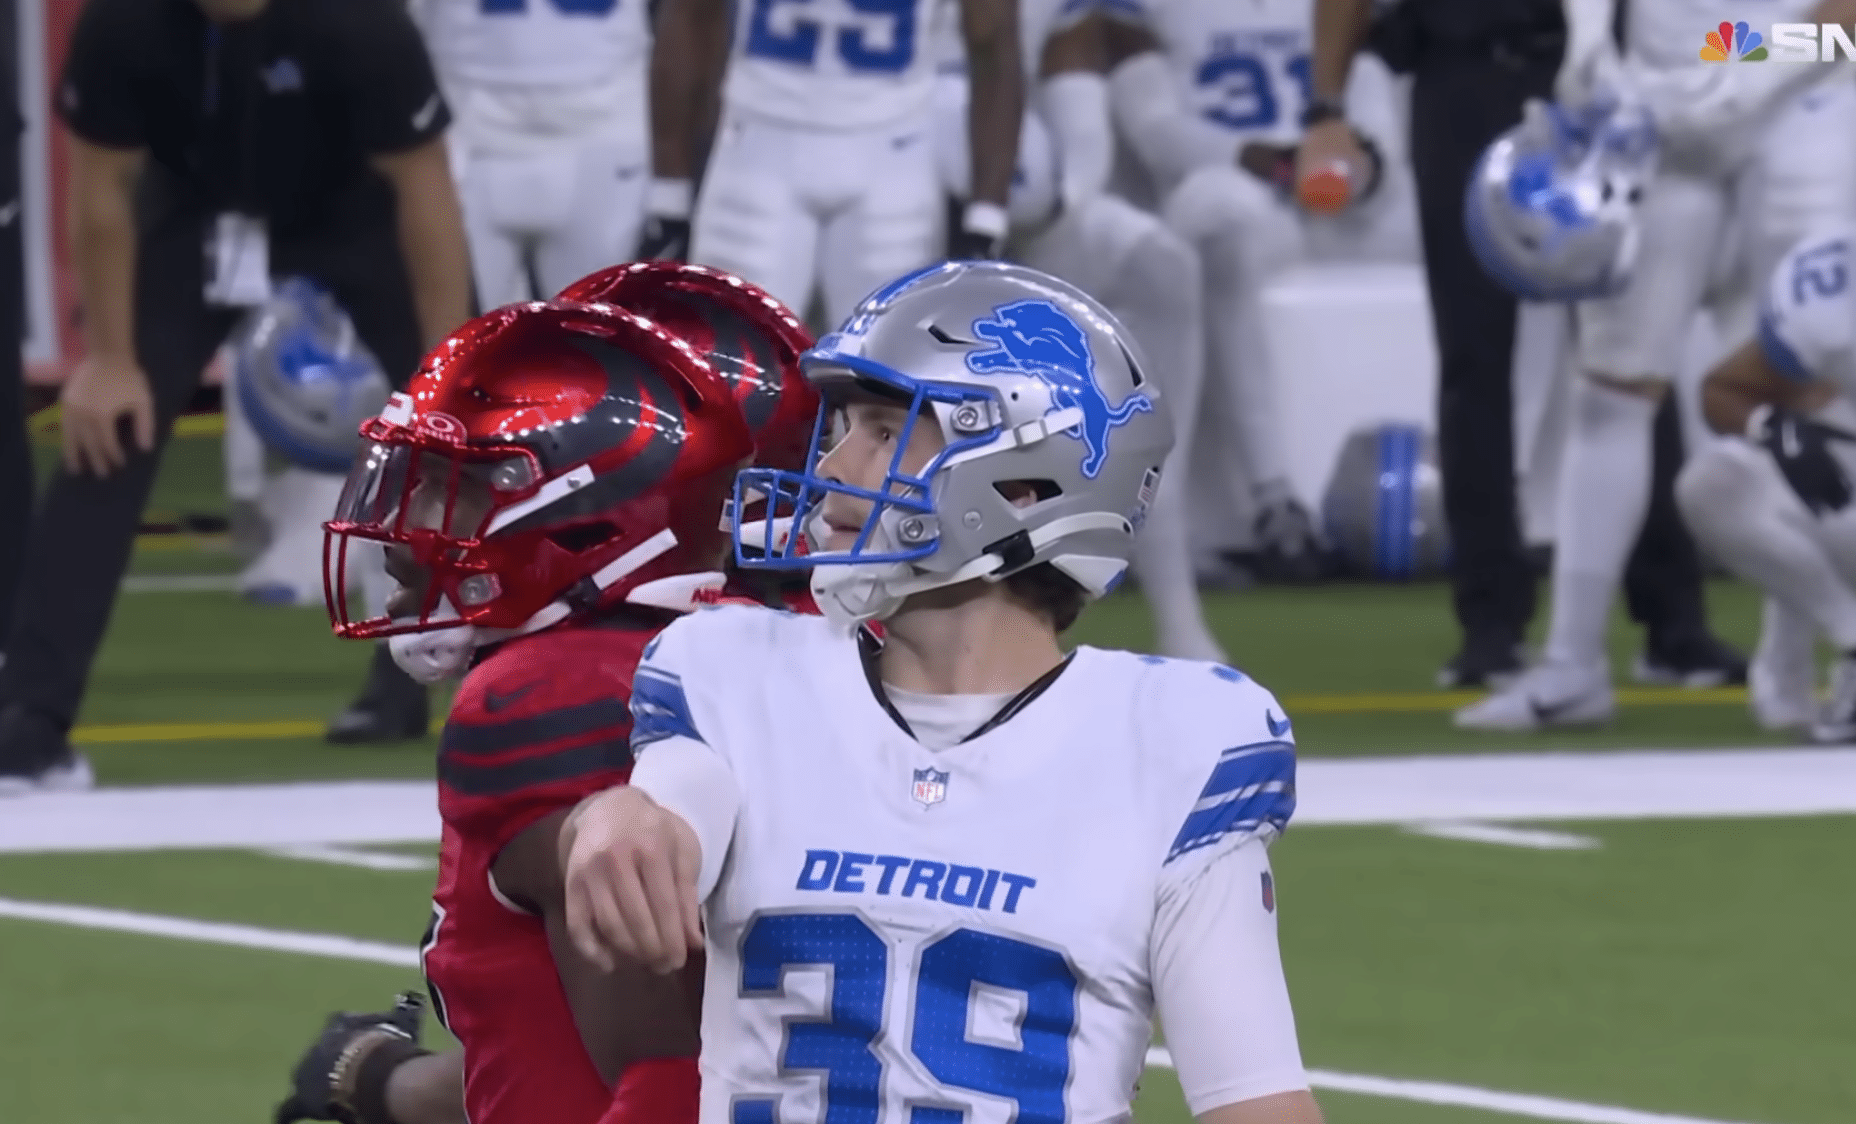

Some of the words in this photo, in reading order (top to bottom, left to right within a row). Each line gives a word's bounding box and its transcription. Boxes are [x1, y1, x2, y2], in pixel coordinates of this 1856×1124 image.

[916, 782, 944, 801] NFL
[796, 849, 1037, 914] DETROIT
[730, 905, 1080, 1124] 39
